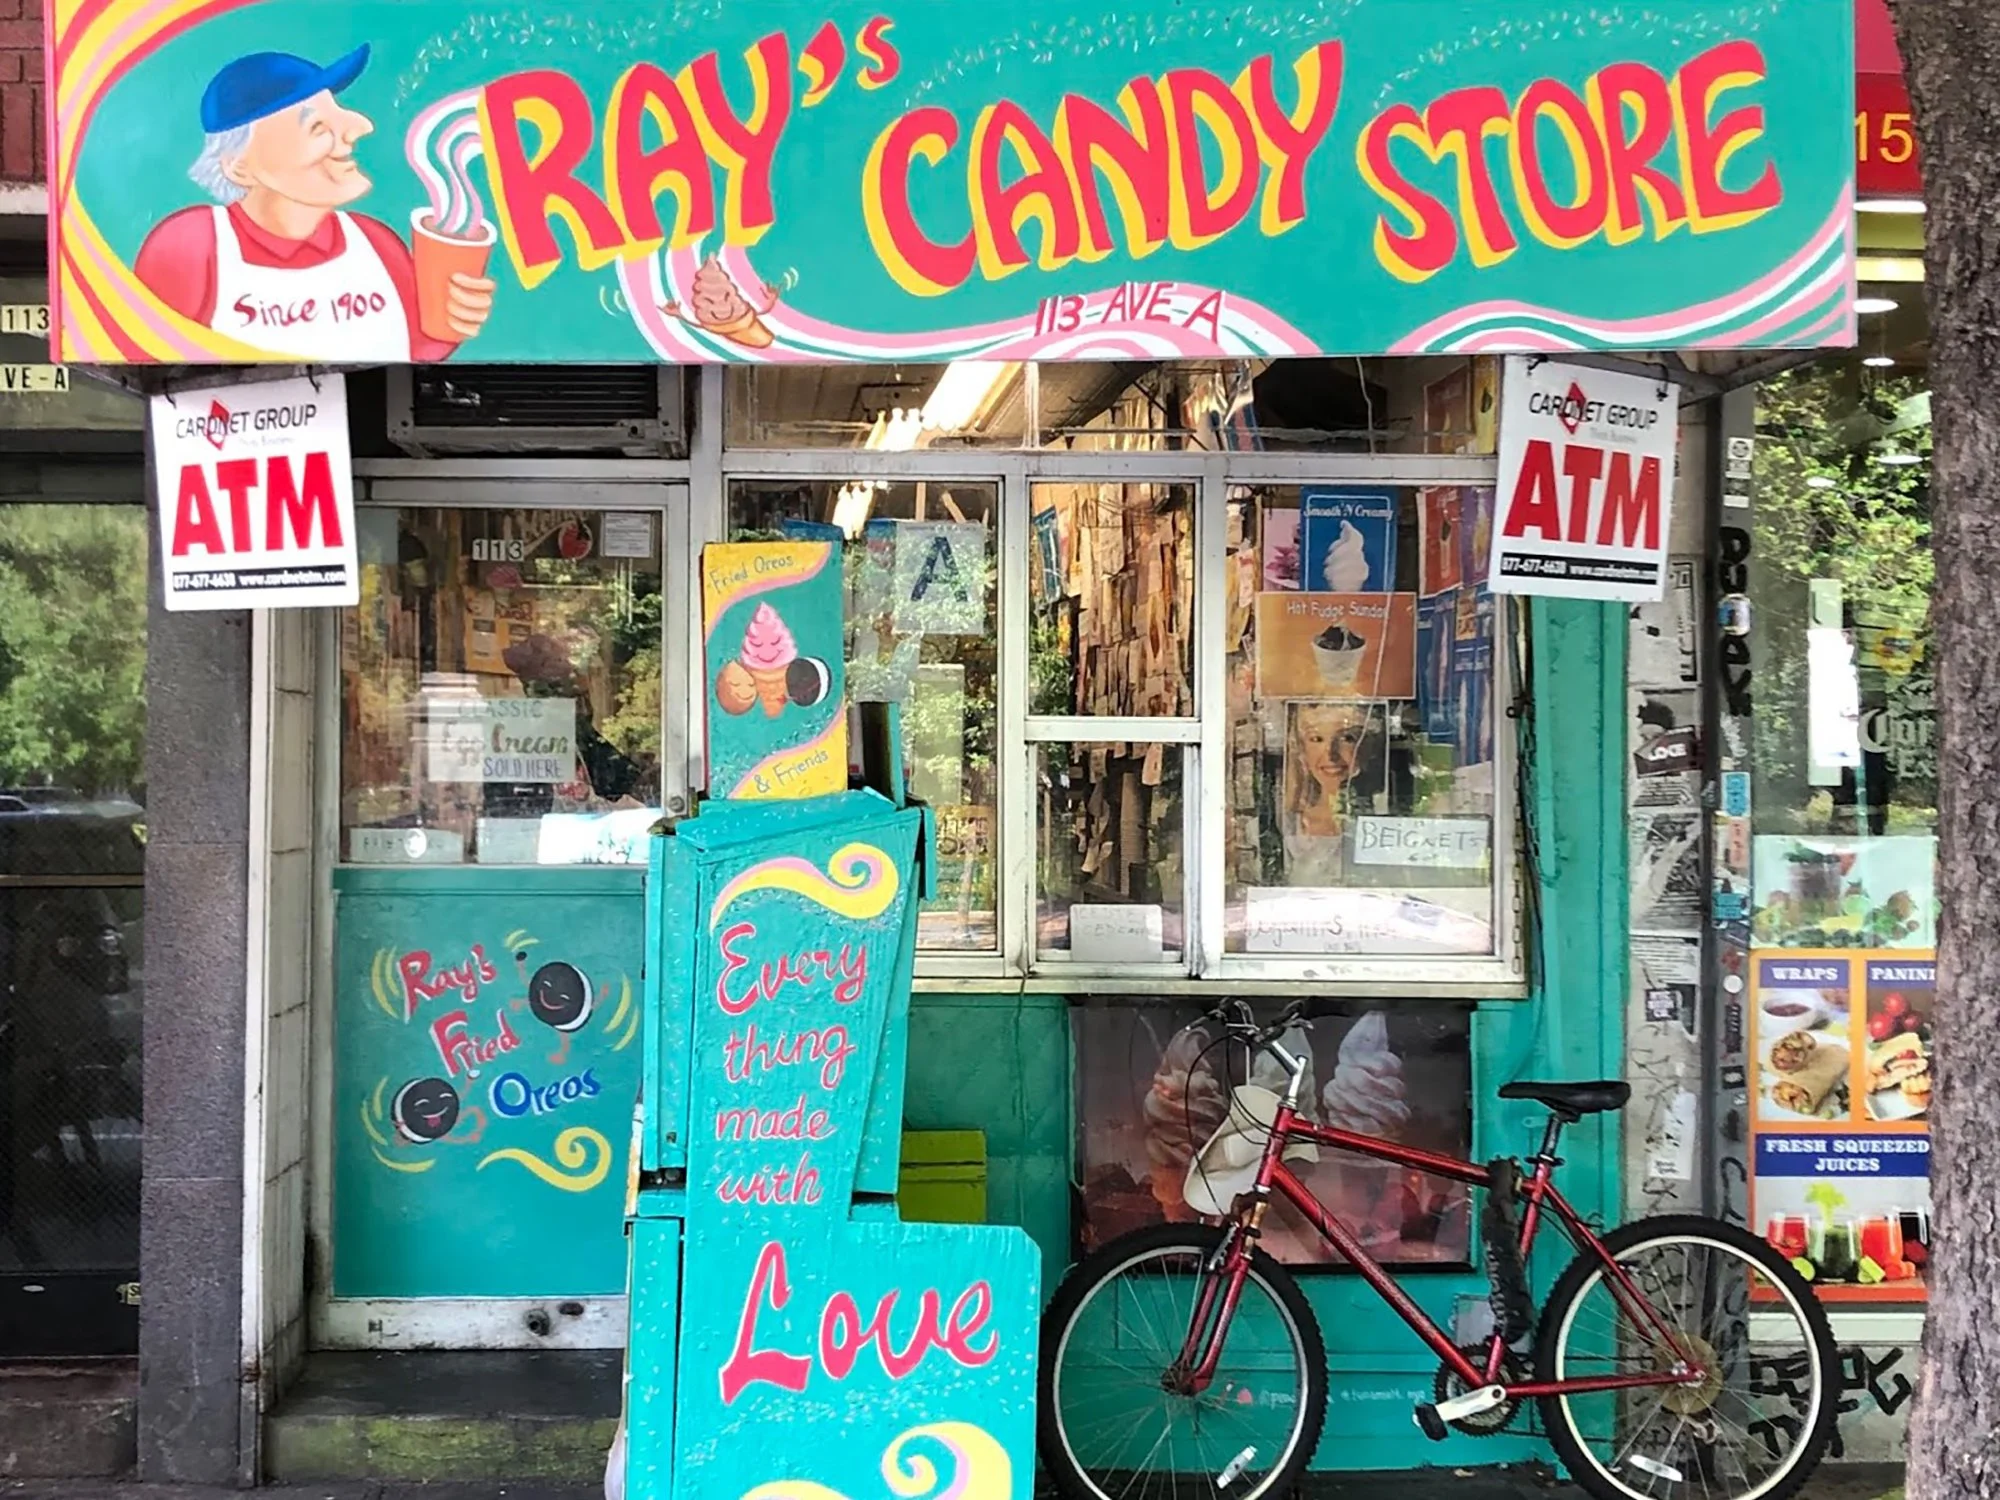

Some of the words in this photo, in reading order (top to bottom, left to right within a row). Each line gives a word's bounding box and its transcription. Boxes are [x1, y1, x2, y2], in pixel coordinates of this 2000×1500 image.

[863, 39, 1343, 297] CANDY
[1357, 41, 1782, 283] STORE
[7, 307, 50, 330] 113
[233, 293, 321, 327] Since
[331, 292, 386, 323] 1900
[1034, 295, 1087, 337] 113
[1101, 281, 1176, 323] AVE
[1182, 291, 1226, 345] A
[254, 404, 317, 431] GROUP
[1607, 404, 1658, 429] GROUP
[172, 452, 344, 556] ATM
[1303, 505, 1340, 517] Smooth
[1354, 504, 1394, 521] Creamy
[1502, 439, 1661, 550] ATM
[473, 540, 523, 560] 113
[910, 536, 968, 602] A
[709, 561, 748, 594] Fried
[754, 556, 795, 573] Oreos
[1287, 601, 1306, 615] Hot
[1311, 601, 1345, 622] Fudge
[458, 700, 543, 718] CLASSIC
[483, 757, 522, 777] SOLD
[526, 758, 565, 778] HERE
[754, 774, 771, 793] &
[772, 750, 828, 786] Friends
[396, 943, 497, 1024] Ray's
[717, 922, 868, 1016] Every
[1772, 967, 1838, 981] WRAPS
[429, 1008, 521, 1078] Fried
[723, 1024, 857, 1090] thing
[488, 1067, 601, 1118] Oreos
[715, 1095, 838, 1142] made
[1765, 1139, 1827, 1153] FRESH
[1832, 1139, 1930, 1154] SQUEEZED
[1815, 1158, 1881, 1172] JUICES
[716, 1153, 823, 1206] with
[720, 1241, 998, 1405] Love
